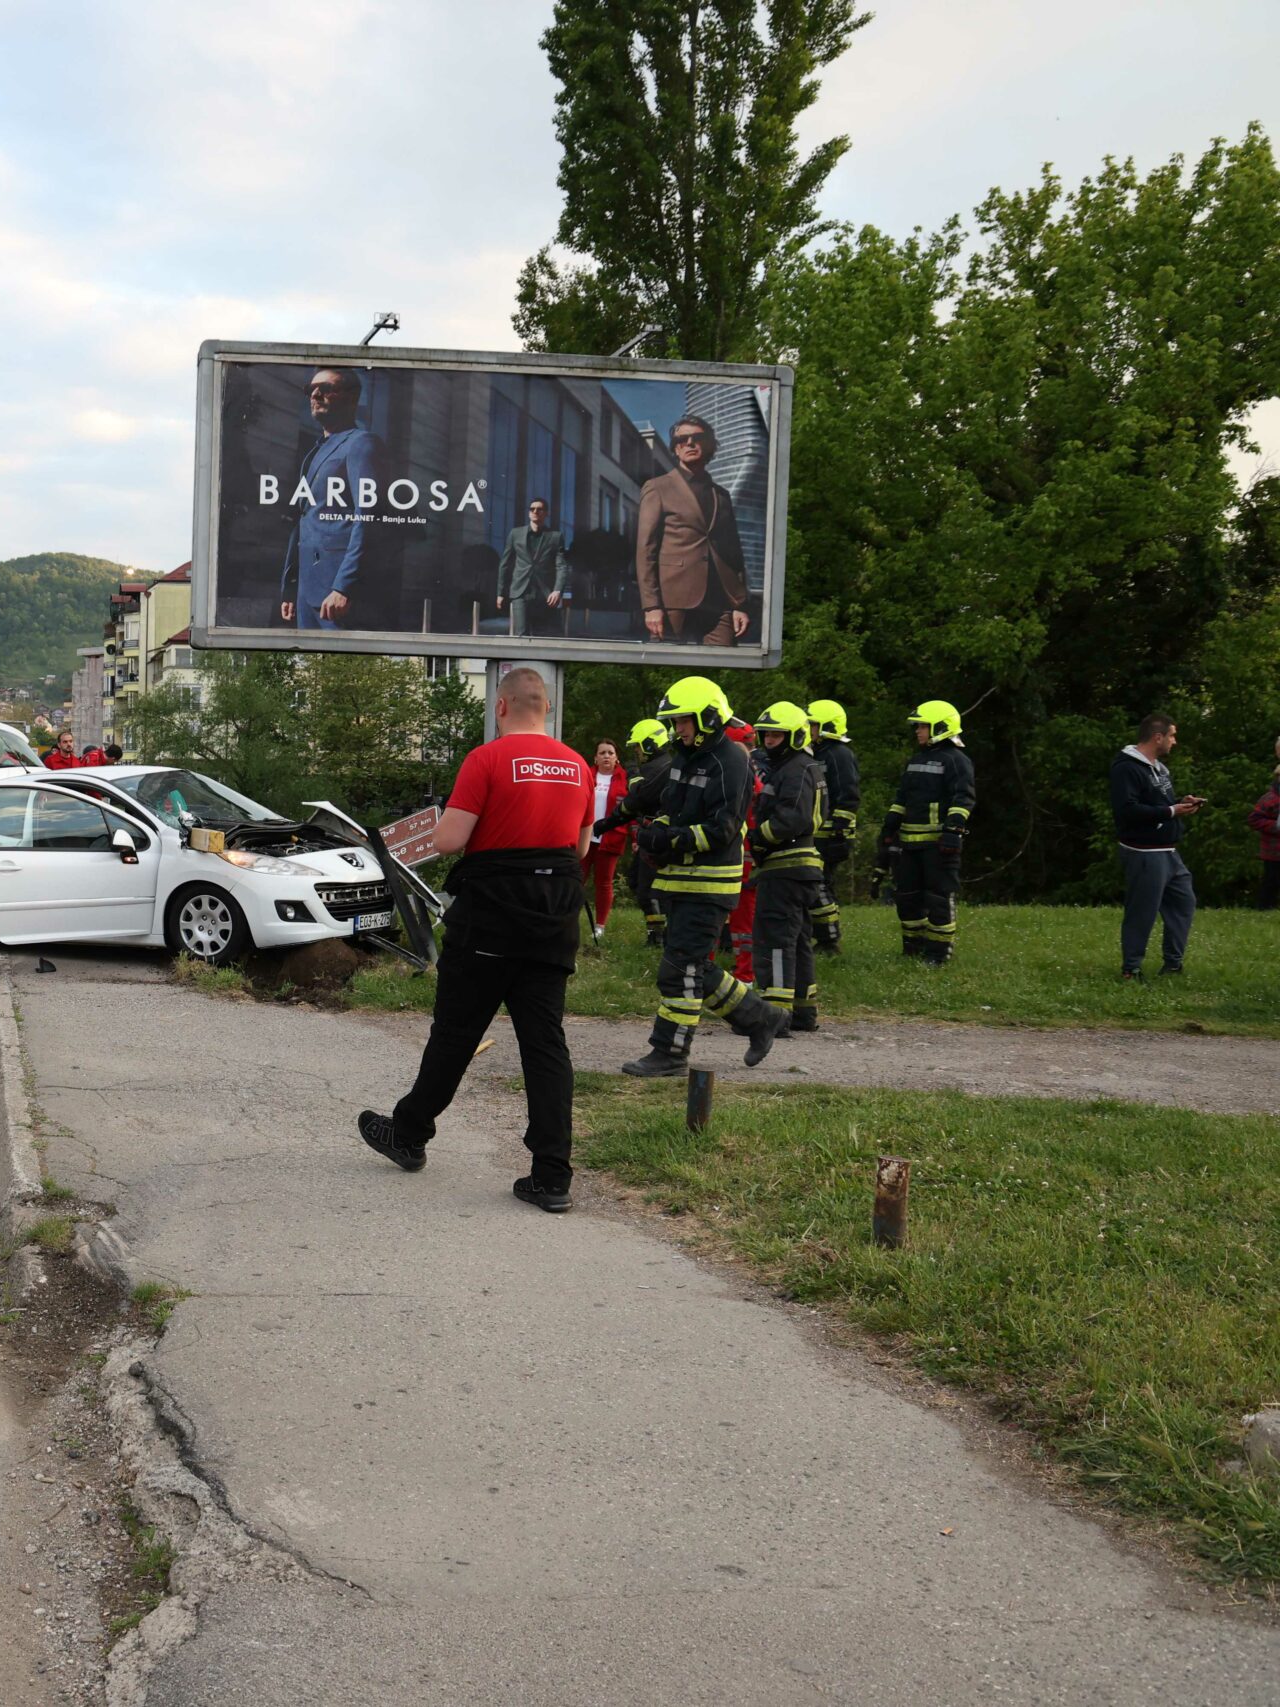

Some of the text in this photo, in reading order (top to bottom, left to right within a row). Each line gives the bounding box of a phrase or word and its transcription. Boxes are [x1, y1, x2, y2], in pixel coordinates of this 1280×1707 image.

[319, 513, 343, 521] DELTA
[345, 514, 375, 522] PLANET
[382, 515, 406, 524] Banja
[407, 516, 427, 524] Luka
[409, 817, 432, 831] 57 km
